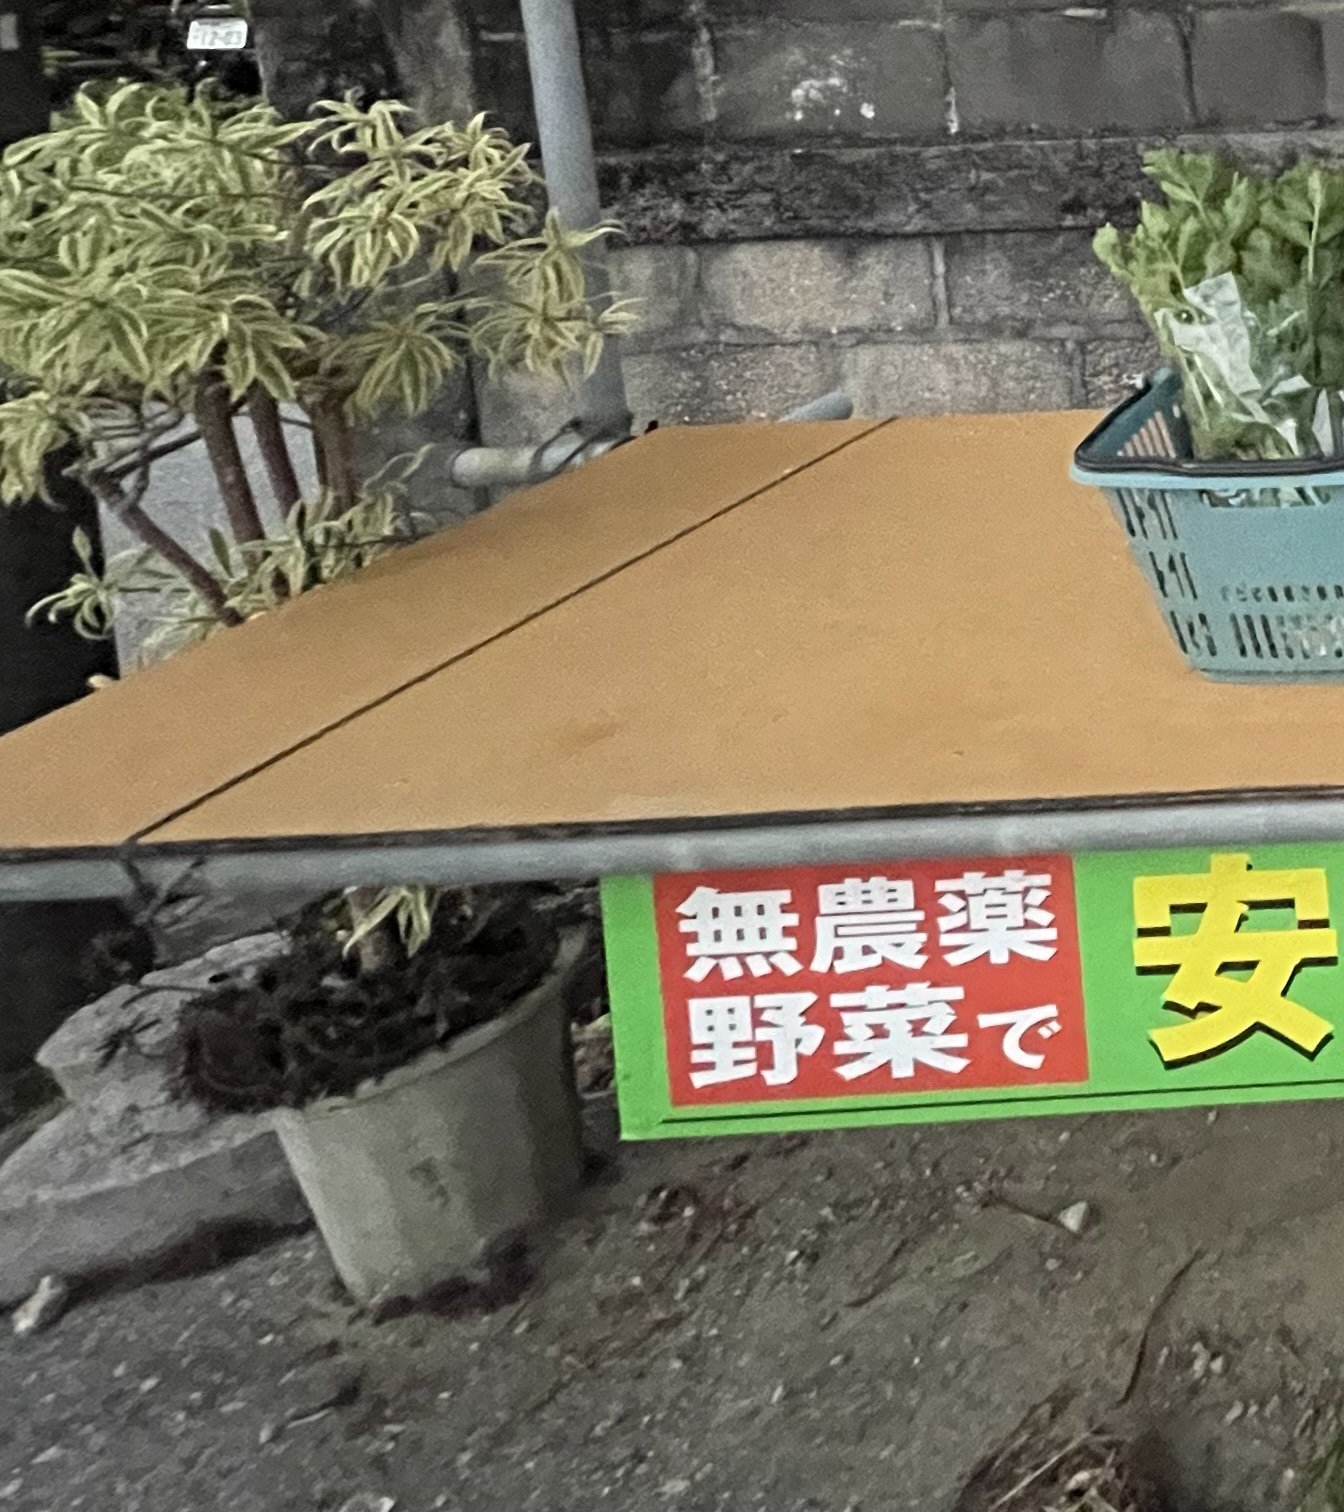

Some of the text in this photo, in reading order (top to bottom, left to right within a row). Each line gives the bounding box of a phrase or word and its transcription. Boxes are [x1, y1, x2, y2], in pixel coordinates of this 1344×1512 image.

[674, 868, 1060, 983] 無農薬
[686, 981, 1063, 1090] 野菜で
